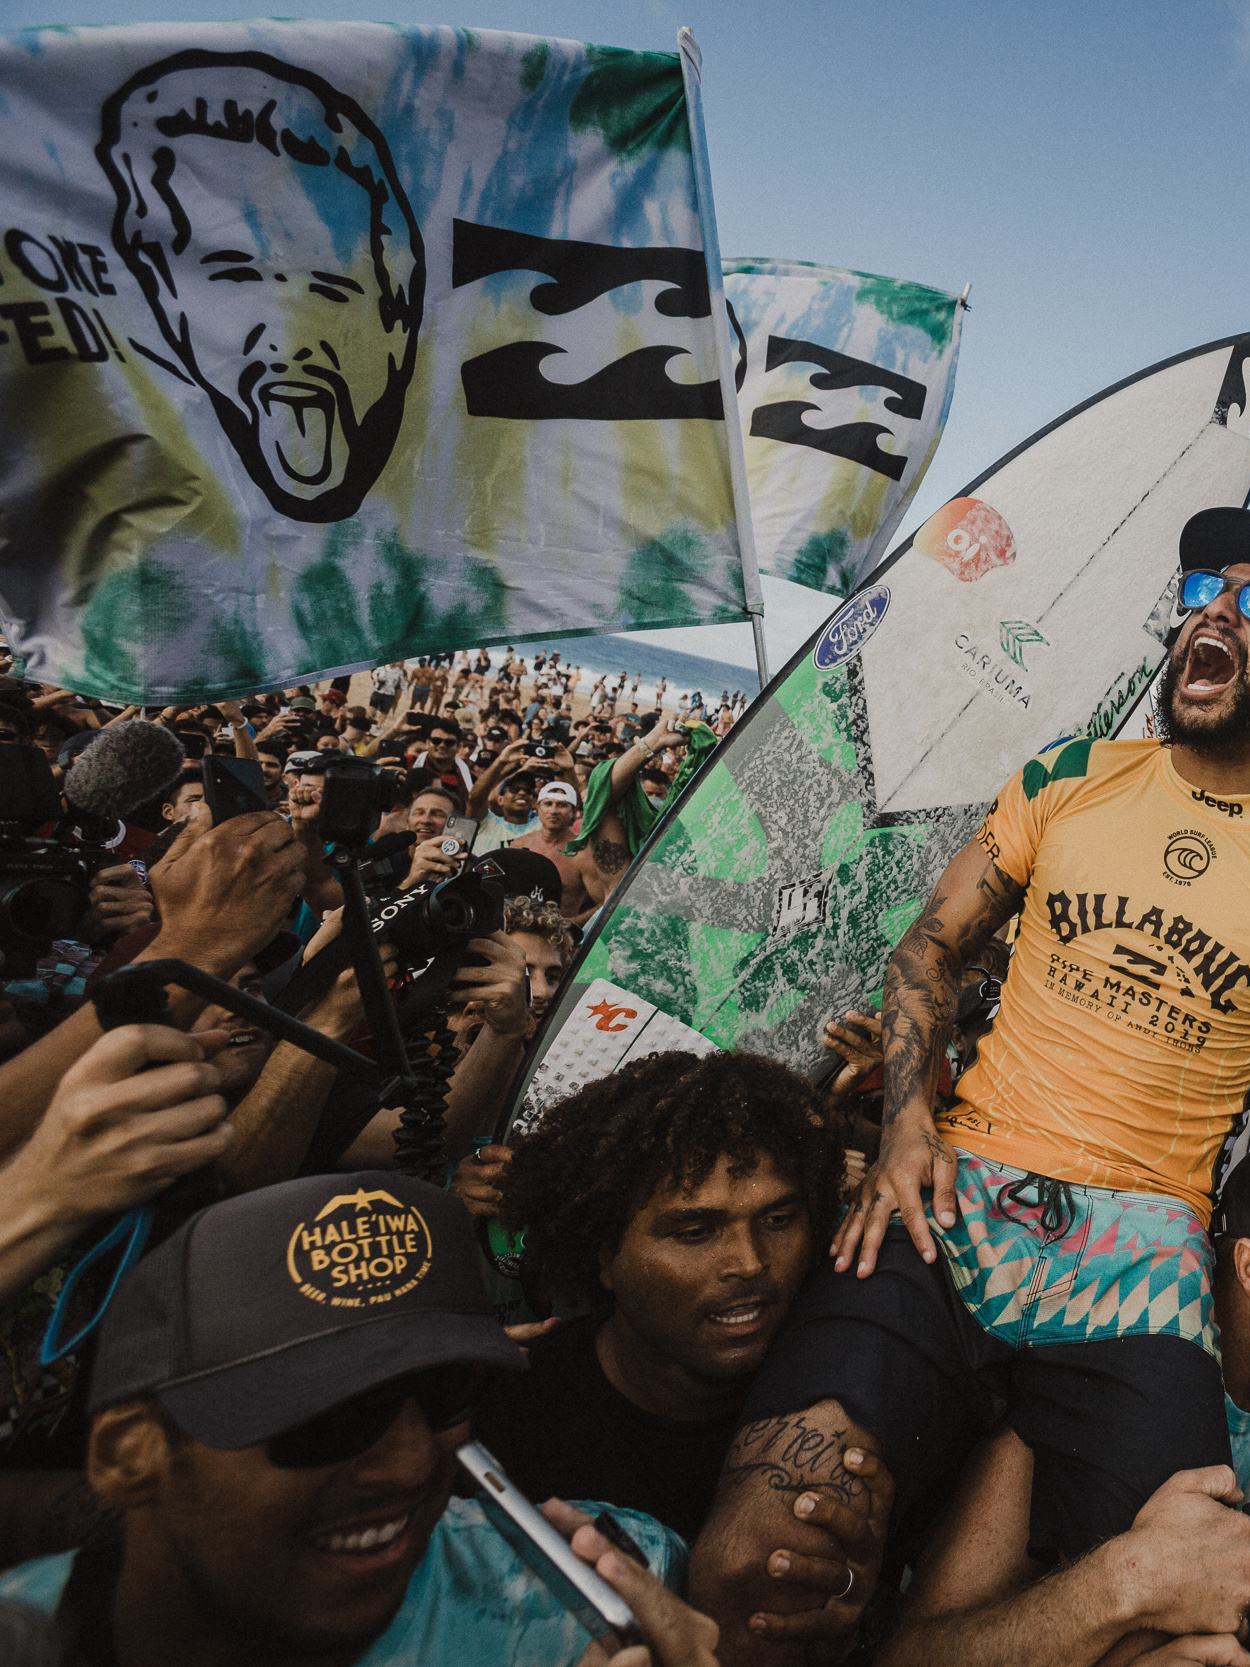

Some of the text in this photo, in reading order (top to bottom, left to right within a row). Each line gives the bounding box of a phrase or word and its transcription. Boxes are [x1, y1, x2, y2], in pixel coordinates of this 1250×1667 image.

[0, 228, 117, 298] OKE
[828, 599, 877, 655] Ford
[955, 634, 1031, 709] CARIUMA
[1191, 789, 1243, 818] Jeep
[1167, 829, 1218, 859] WORLD SURF LEAGUE
[1162, 871, 1173, 883] EST.
[1044, 980, 1055, 990] IN
[1058, 988, 1102, 1013] MEMORY
[1107, 1010, 1122, 1022] OF
[1047, 965, 1207, 1047] HAWAII 2019
[1103, 976, 1213, 1034] MASTERS
[310, 1234, 418, 1271] BOTTLE
[330, 1255, 408, 1288] SHOP
